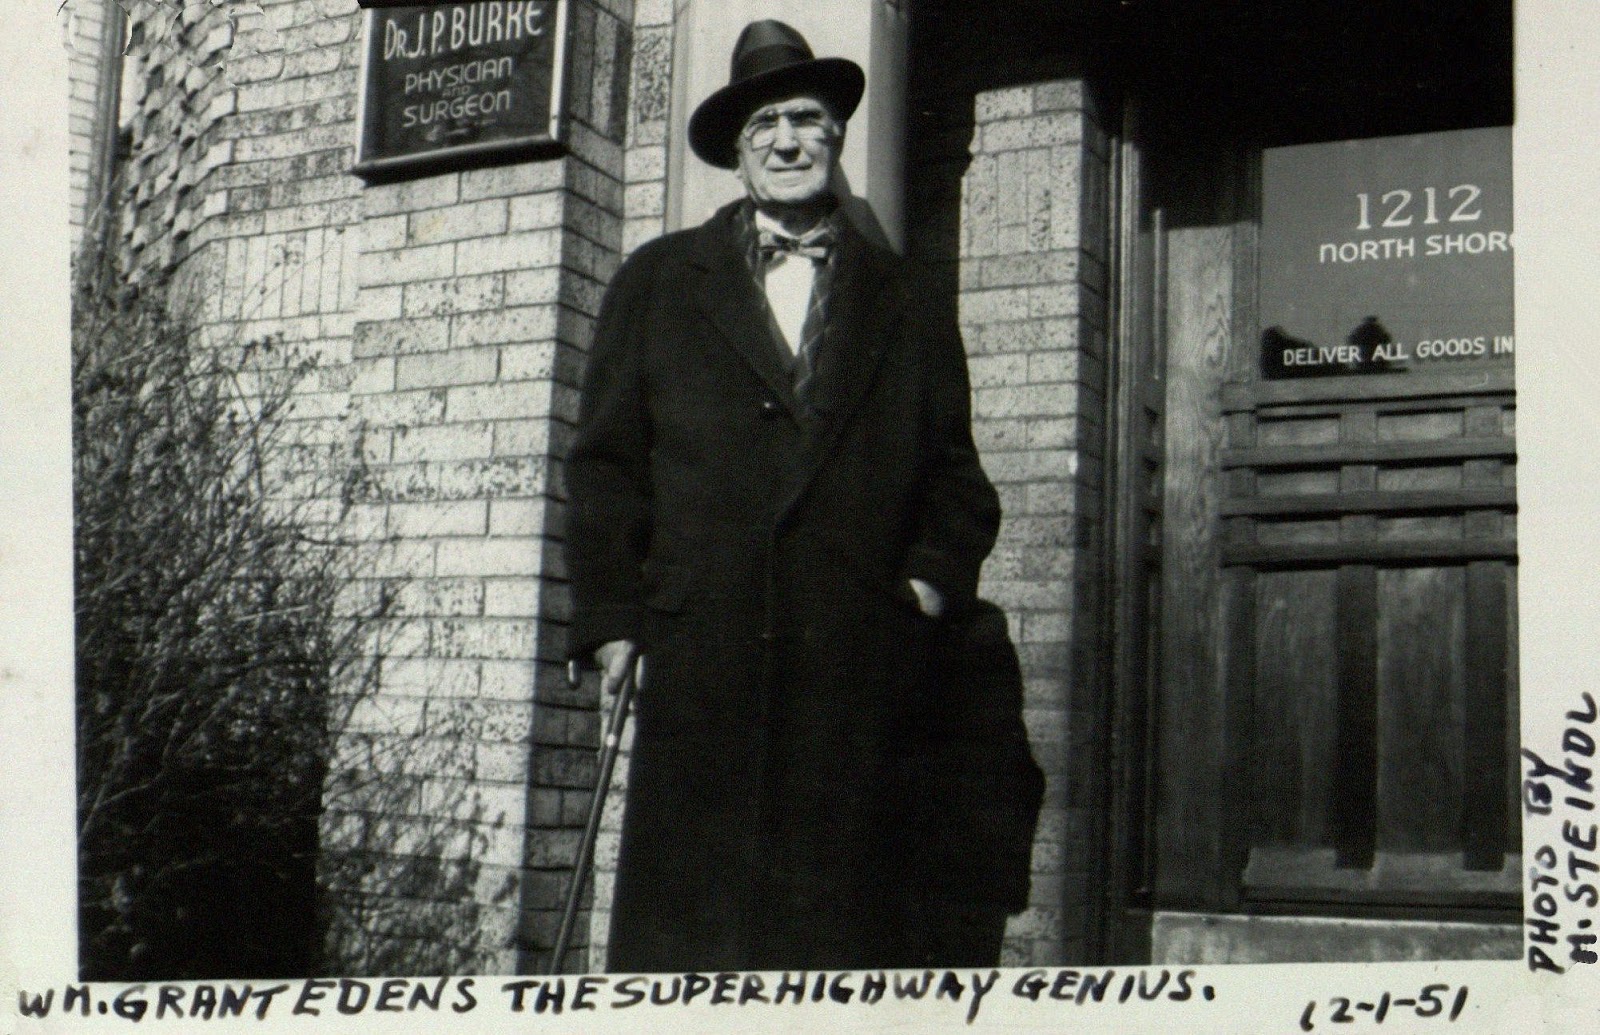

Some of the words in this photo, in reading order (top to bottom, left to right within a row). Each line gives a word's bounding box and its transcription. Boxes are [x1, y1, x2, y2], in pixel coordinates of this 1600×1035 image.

[451, 1, 542, 49] BURKE
[404, 56, 513, 95] PHYSICIAN
[402, 89, 511, 128] SURGEON
[1356, 183, 1482, 230] 1212
[1319, 237, 1415, 264] NORTH
[1283, 345, 1362, 367] DELIVER
[1371, 342, 1409, 361] ALL
[1416, 336, 1486, 359] GOODS
[1493, 335, 1514, 354] IN
[1521, 747, 1568, 818] BY
[1527, 845, 1565, 975] PHOTO
[113, 984, 290, 1023] GRANT
[292, 977, 478, 1017] EDENS
[501, 977, 609, 1015] THE
[610, 968, 1000, 1025] SUPERHIGHWAY
[1011, 969, 1216, 1006] GENIUS.
